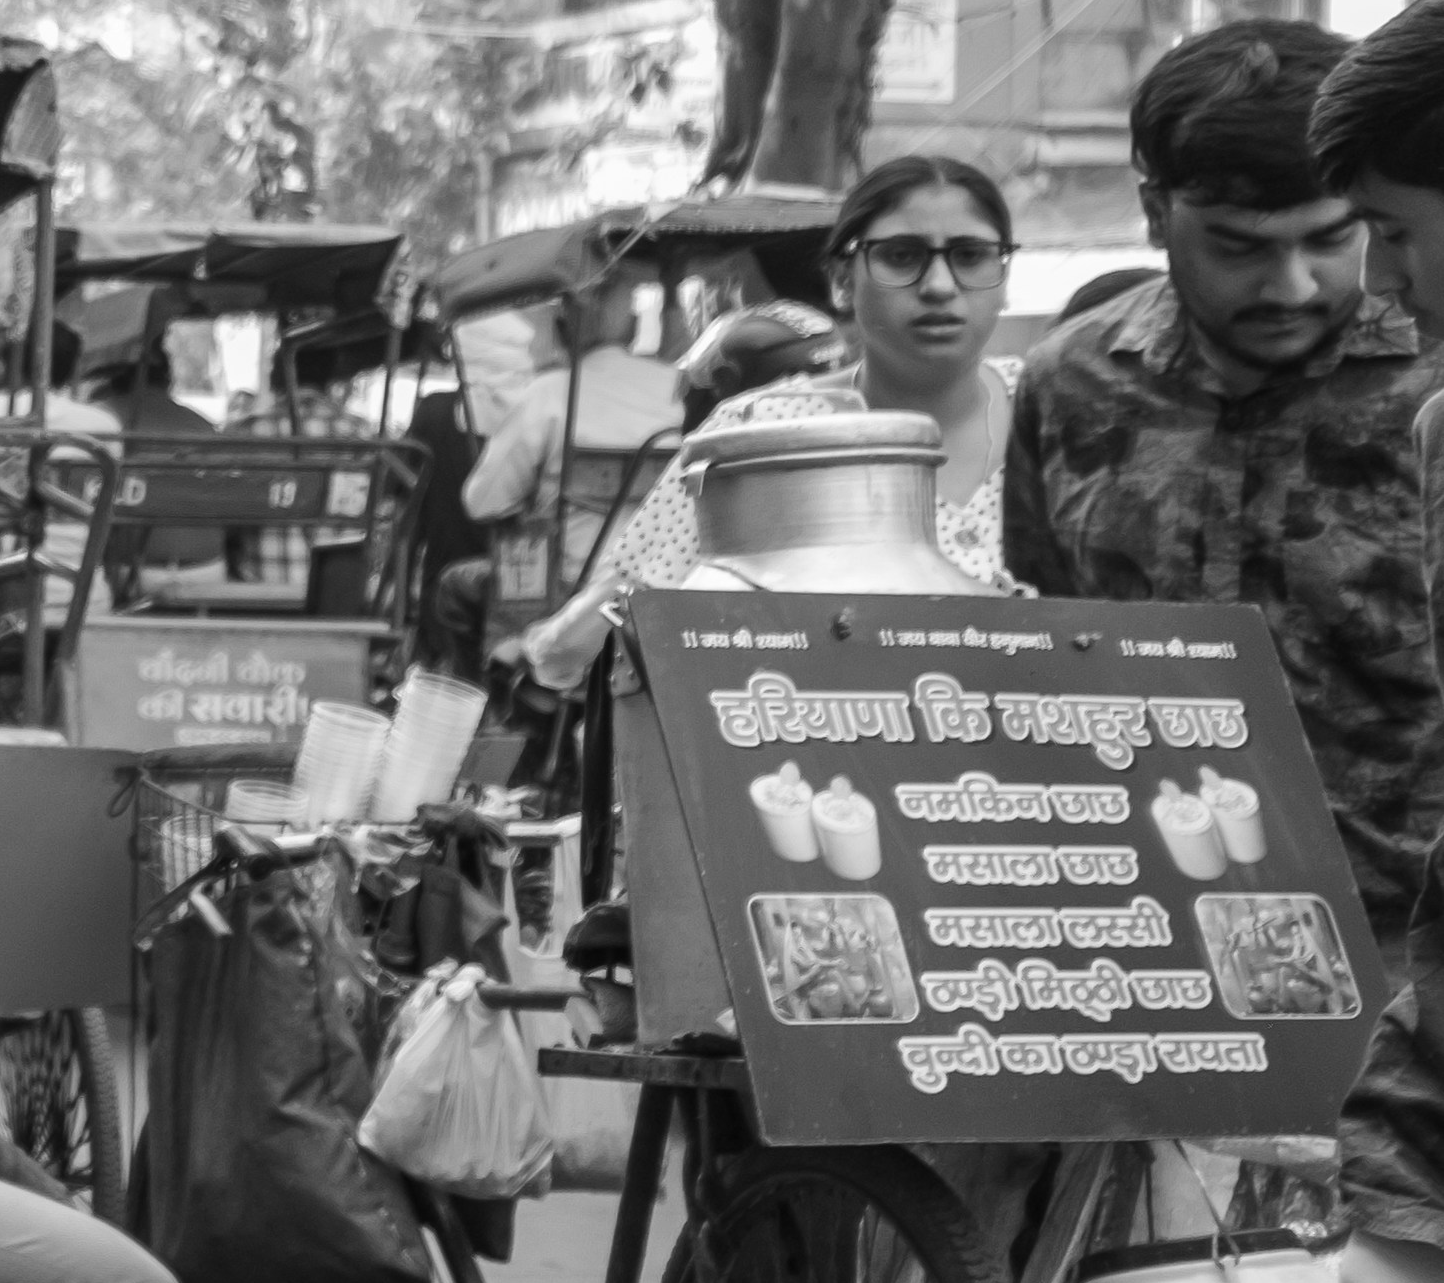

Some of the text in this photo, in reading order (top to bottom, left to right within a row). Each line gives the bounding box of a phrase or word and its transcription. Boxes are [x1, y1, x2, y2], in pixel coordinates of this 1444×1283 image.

[709, 671, 916, 748] हरियाणा
[914, 670, 994, 745] कि
[1146, 696, 1250, 749] छाछ
[894, 770, 1131, 825] नमकिन छाछ
[922, 844, 1140, 886] मसाला छाछ
[923, 894, 1173, 949] मसाला लस्सी
[920, 957, 1020, 1022] ठण्डी
[1127, 968, 1213, 1011] छाछ
[995, 1033, 1064, 1075] का
[1058, 1032, 1159, 1086] ठण्डा
[1154, 1031, 1269, 1073] रायता
